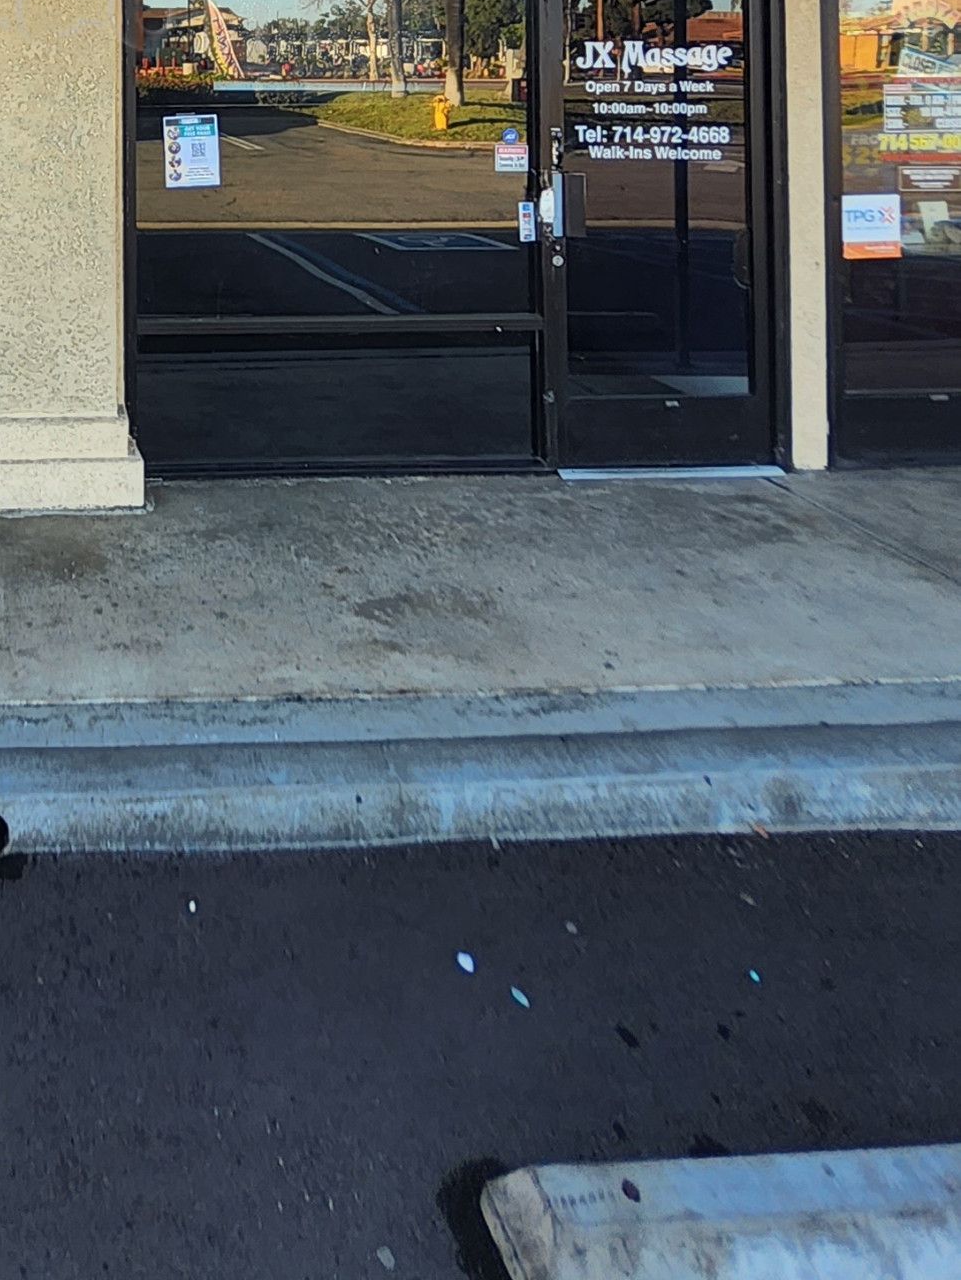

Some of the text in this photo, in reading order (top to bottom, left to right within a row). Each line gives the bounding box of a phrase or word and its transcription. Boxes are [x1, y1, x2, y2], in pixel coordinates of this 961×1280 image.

[576, 40, 733, 78] JX Massage
[585, 81, 715, 95] Open 7 Days a Week
[575, 125, 730, 144] Tel: 714-972-4668
[589, 146, 722, 160] Walk-Ins Welcome
[844, 208, 875, 222] TPG
